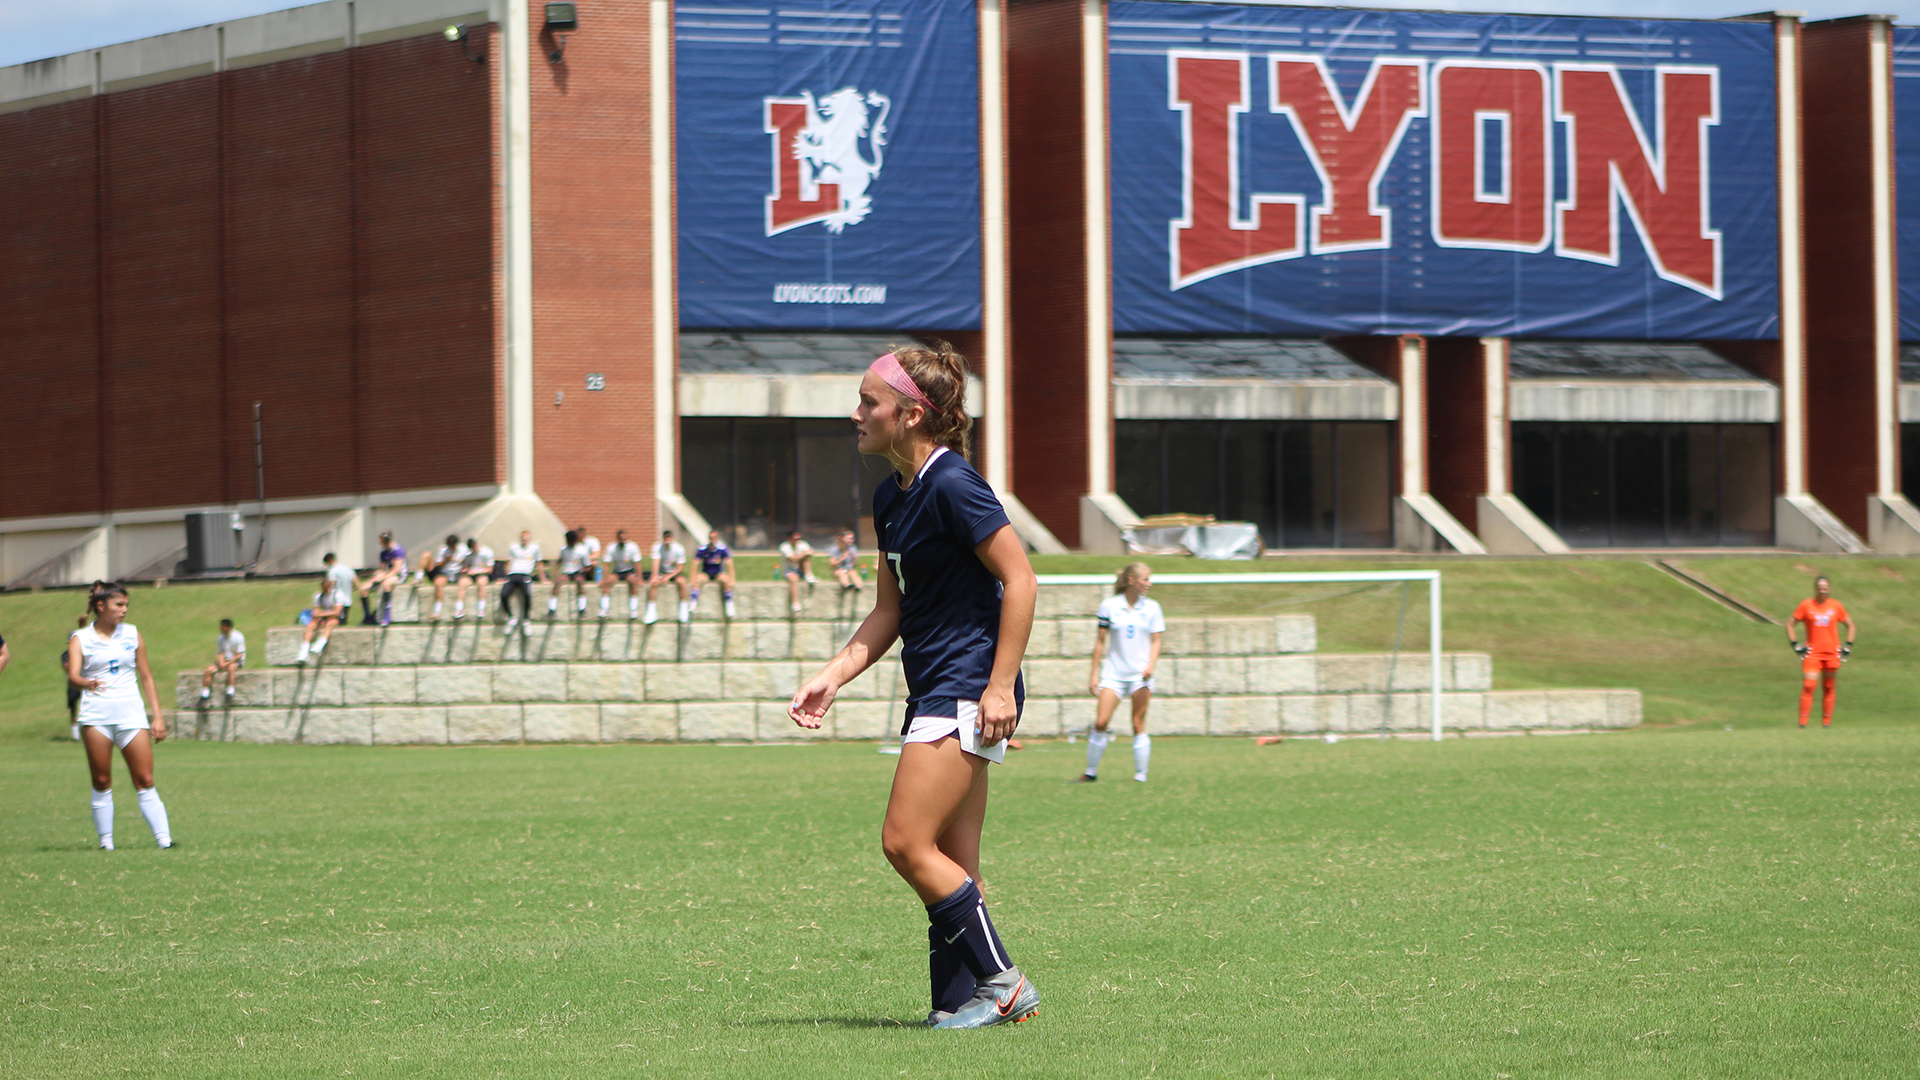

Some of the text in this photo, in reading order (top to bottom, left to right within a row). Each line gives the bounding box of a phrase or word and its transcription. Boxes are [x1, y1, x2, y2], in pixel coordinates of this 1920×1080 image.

[1167, 49, 1723, 301] LYON
[773, 283, 887, 304] LYONSCOTS.COM
[586, 374, 606, 391] 25
[1126, 624, 1136, 639] 9
